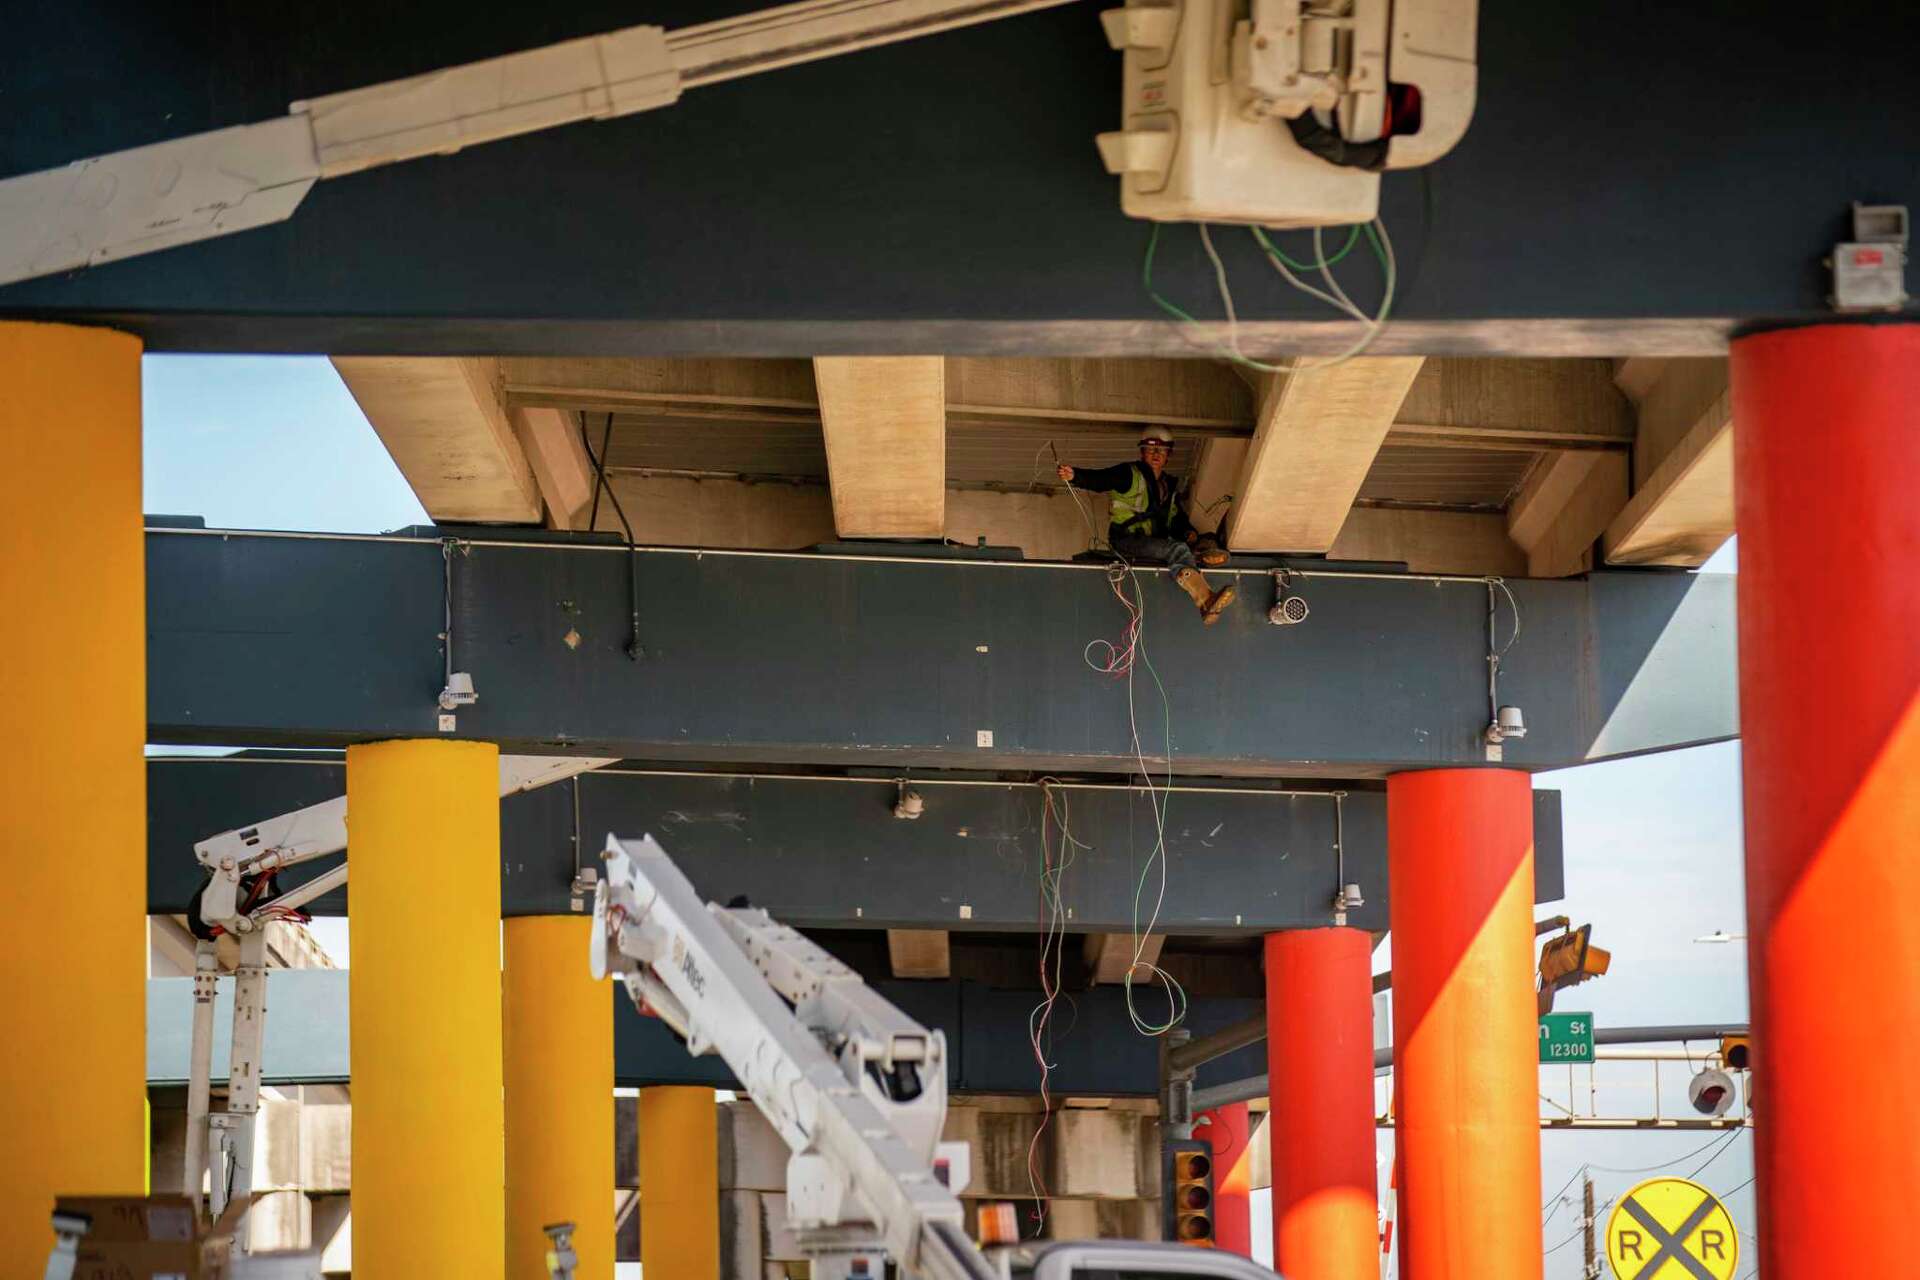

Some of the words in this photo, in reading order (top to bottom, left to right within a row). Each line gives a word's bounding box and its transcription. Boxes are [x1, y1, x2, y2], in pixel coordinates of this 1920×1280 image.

[1570, 1021, 1586, 1034] St
[1551, 1043, 1587, 1056] 12300
[1619, 1230, 1642, 1260] R
[1701, 1230, 1725, 1259] R
